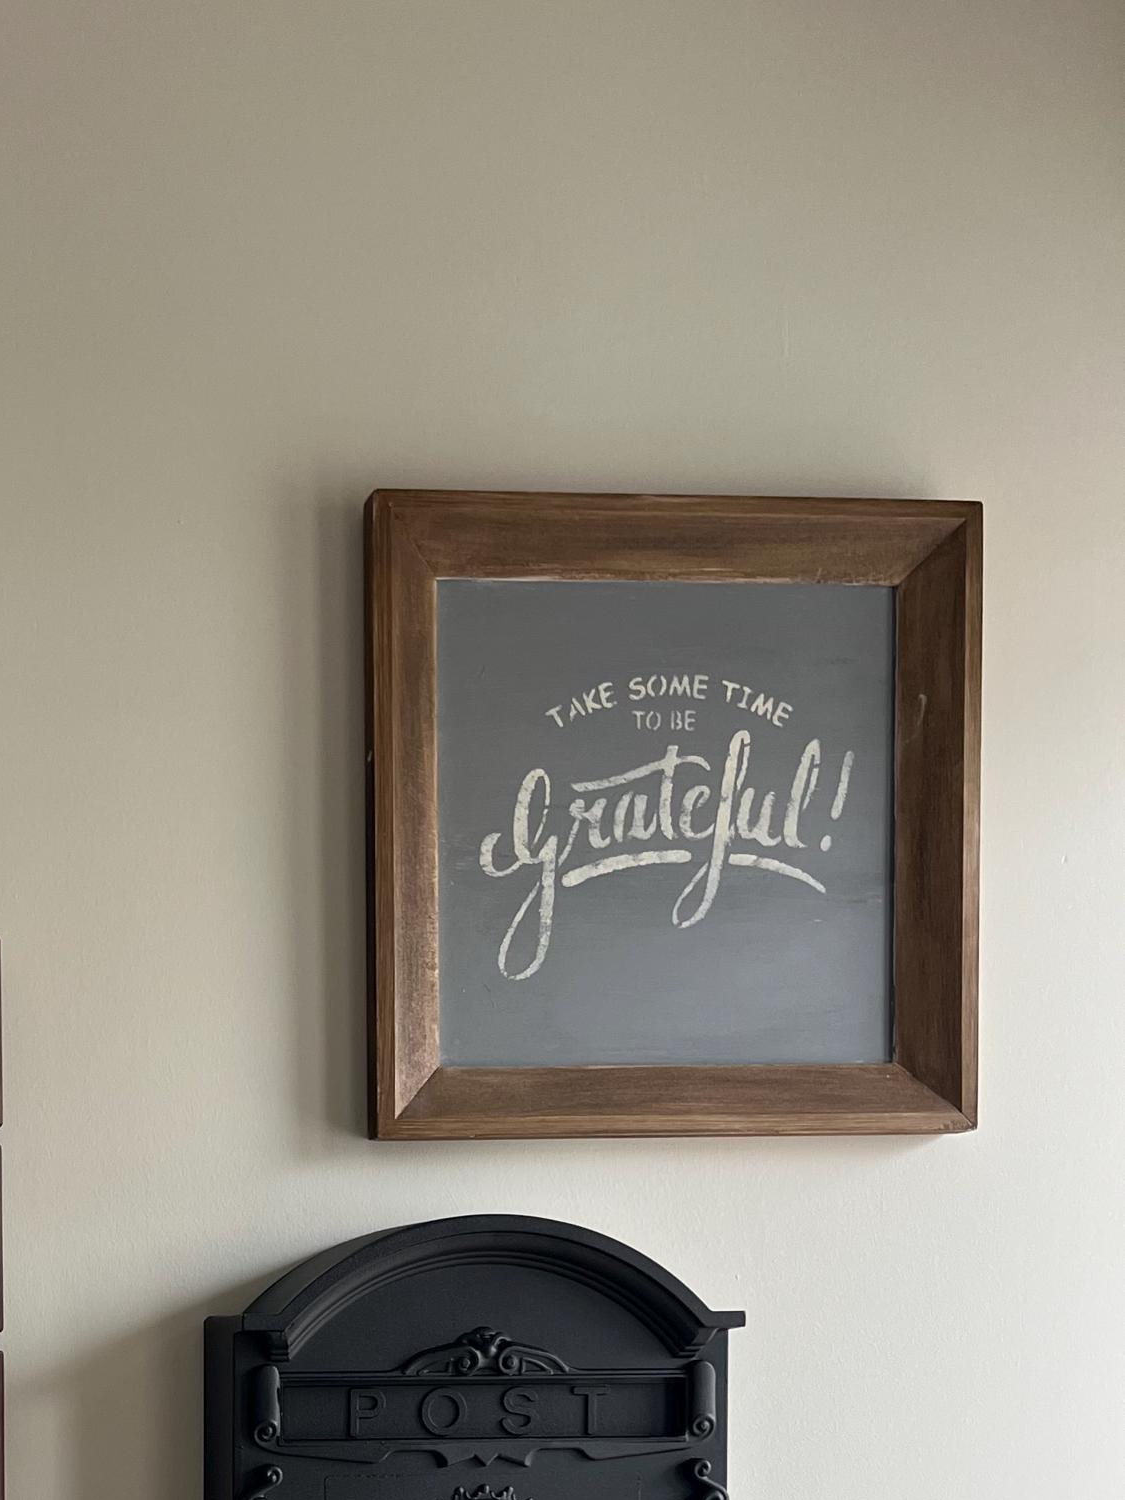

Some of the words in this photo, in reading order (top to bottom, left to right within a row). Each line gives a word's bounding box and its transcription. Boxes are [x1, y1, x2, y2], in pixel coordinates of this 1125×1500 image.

[545, 682, 618, 728] TAKE
[628, 674, 709, 700] SOME
[721, 679, 793, 727] TIME
[633, 710, 661, 731] TO
[671, 710, 696, 731] BE
[348, 1386, 611, 1438] POST
